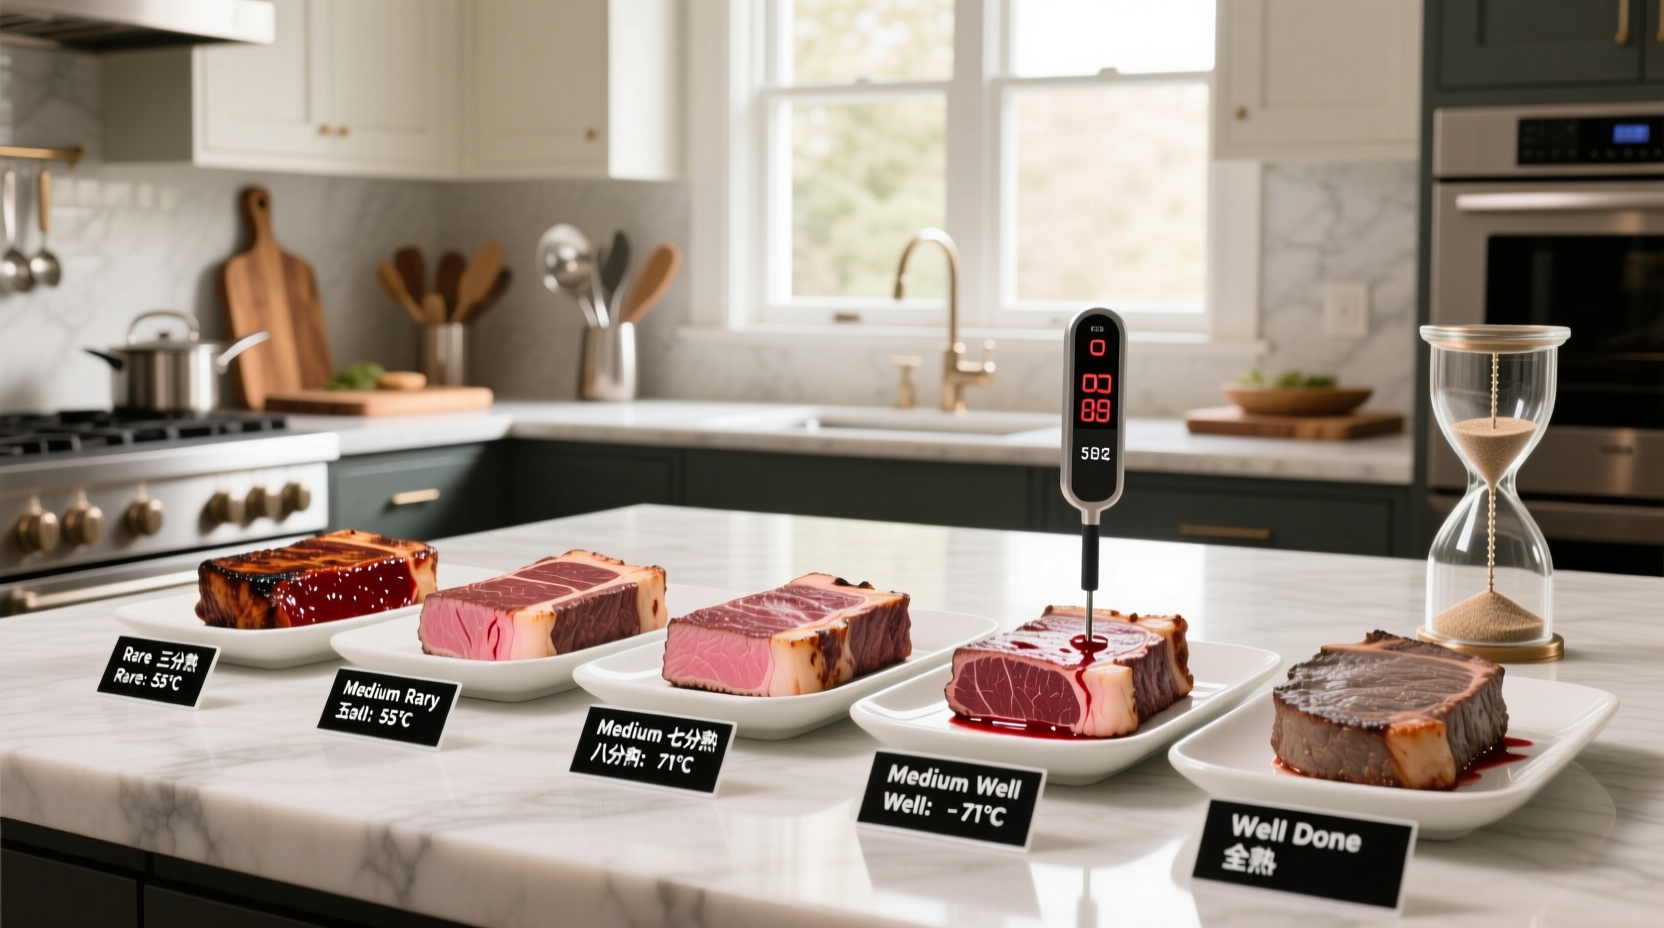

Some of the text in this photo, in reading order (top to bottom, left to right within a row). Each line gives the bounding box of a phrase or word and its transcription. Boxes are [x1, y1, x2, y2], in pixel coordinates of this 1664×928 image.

[123, 646, 153, 665] Rare
[113, 668, 148, 686] Rare:
[342, 679, 440, 712] Medium Rary
[596, 718, 663, 743] Medium
[887, 763, 1022, 800] Medium Well
[883, 791, 933, 817] Well:
[1232, 813, 1362, 853] Well Done
